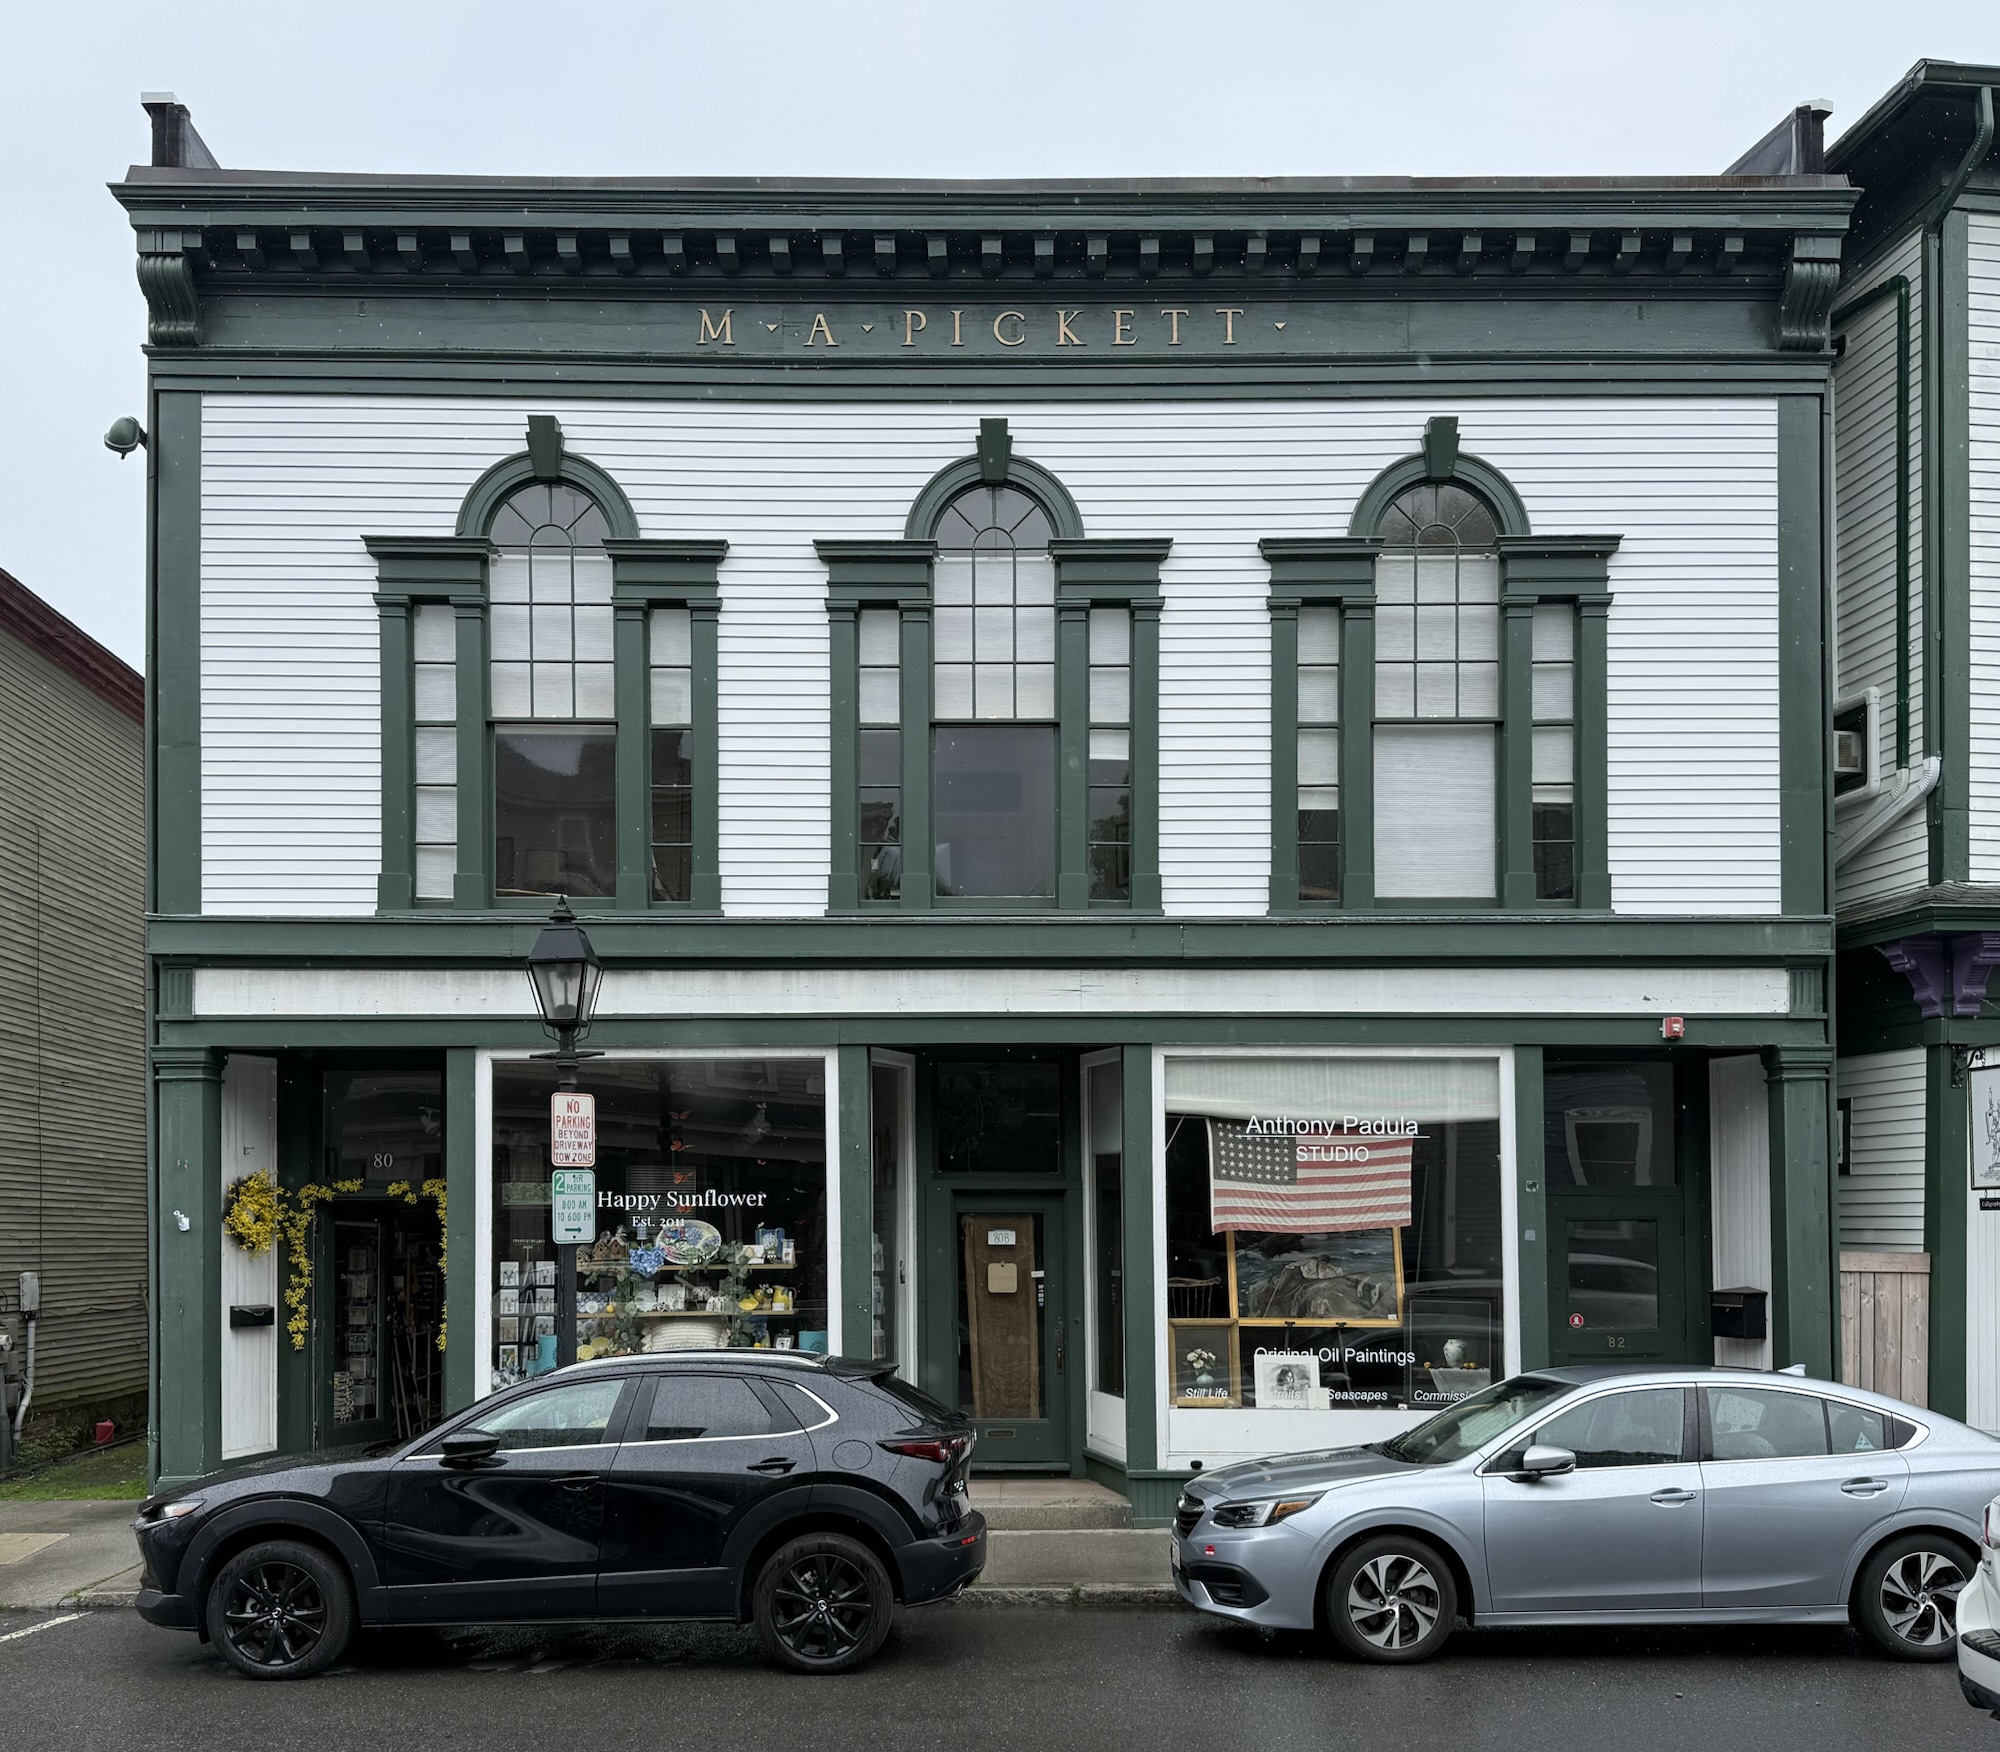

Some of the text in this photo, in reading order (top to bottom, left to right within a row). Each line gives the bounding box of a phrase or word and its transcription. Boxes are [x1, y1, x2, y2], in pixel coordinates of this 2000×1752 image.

[697, 308, 1244, 346] M A PICKETT
[566, 1101, 580, 1113] NO
[556, 1115, 591, 1129] PARKING
[1246, 1115, 1418, 1139] Anthony Padula
[558, 1129, 589, 1139] BEYOND
[555, 1141, 592, 1150] DRIVEWAY
[555, 1153, 592, 1162] TOW ZONE
[1296, 1146, 1369, 1162] STUDIO
[373, 1153, 393, 1168] 80
[555, 1173, 583, 1191] 2 HR
[566, 1184, 592, 1192] PARKING
[578, 1200, 587, 1209] AM
[597, 1189, 767, 1210] Happy Sunflower
[557, 1212, 565, 1221] TO
[583, 1212, 592, 1221] PM
[632, 1216, 685, 1227] Est. 2011
[1608, 1336, 1625, 1348] 82
[1319, 1347, 1340, 1363] Oil
[1345, 1348, 1416, 1366] Paintings
[1185, 1387, 1228, 1398] Still Life
[1328, 1389, 1388, 1402] Seascapes
